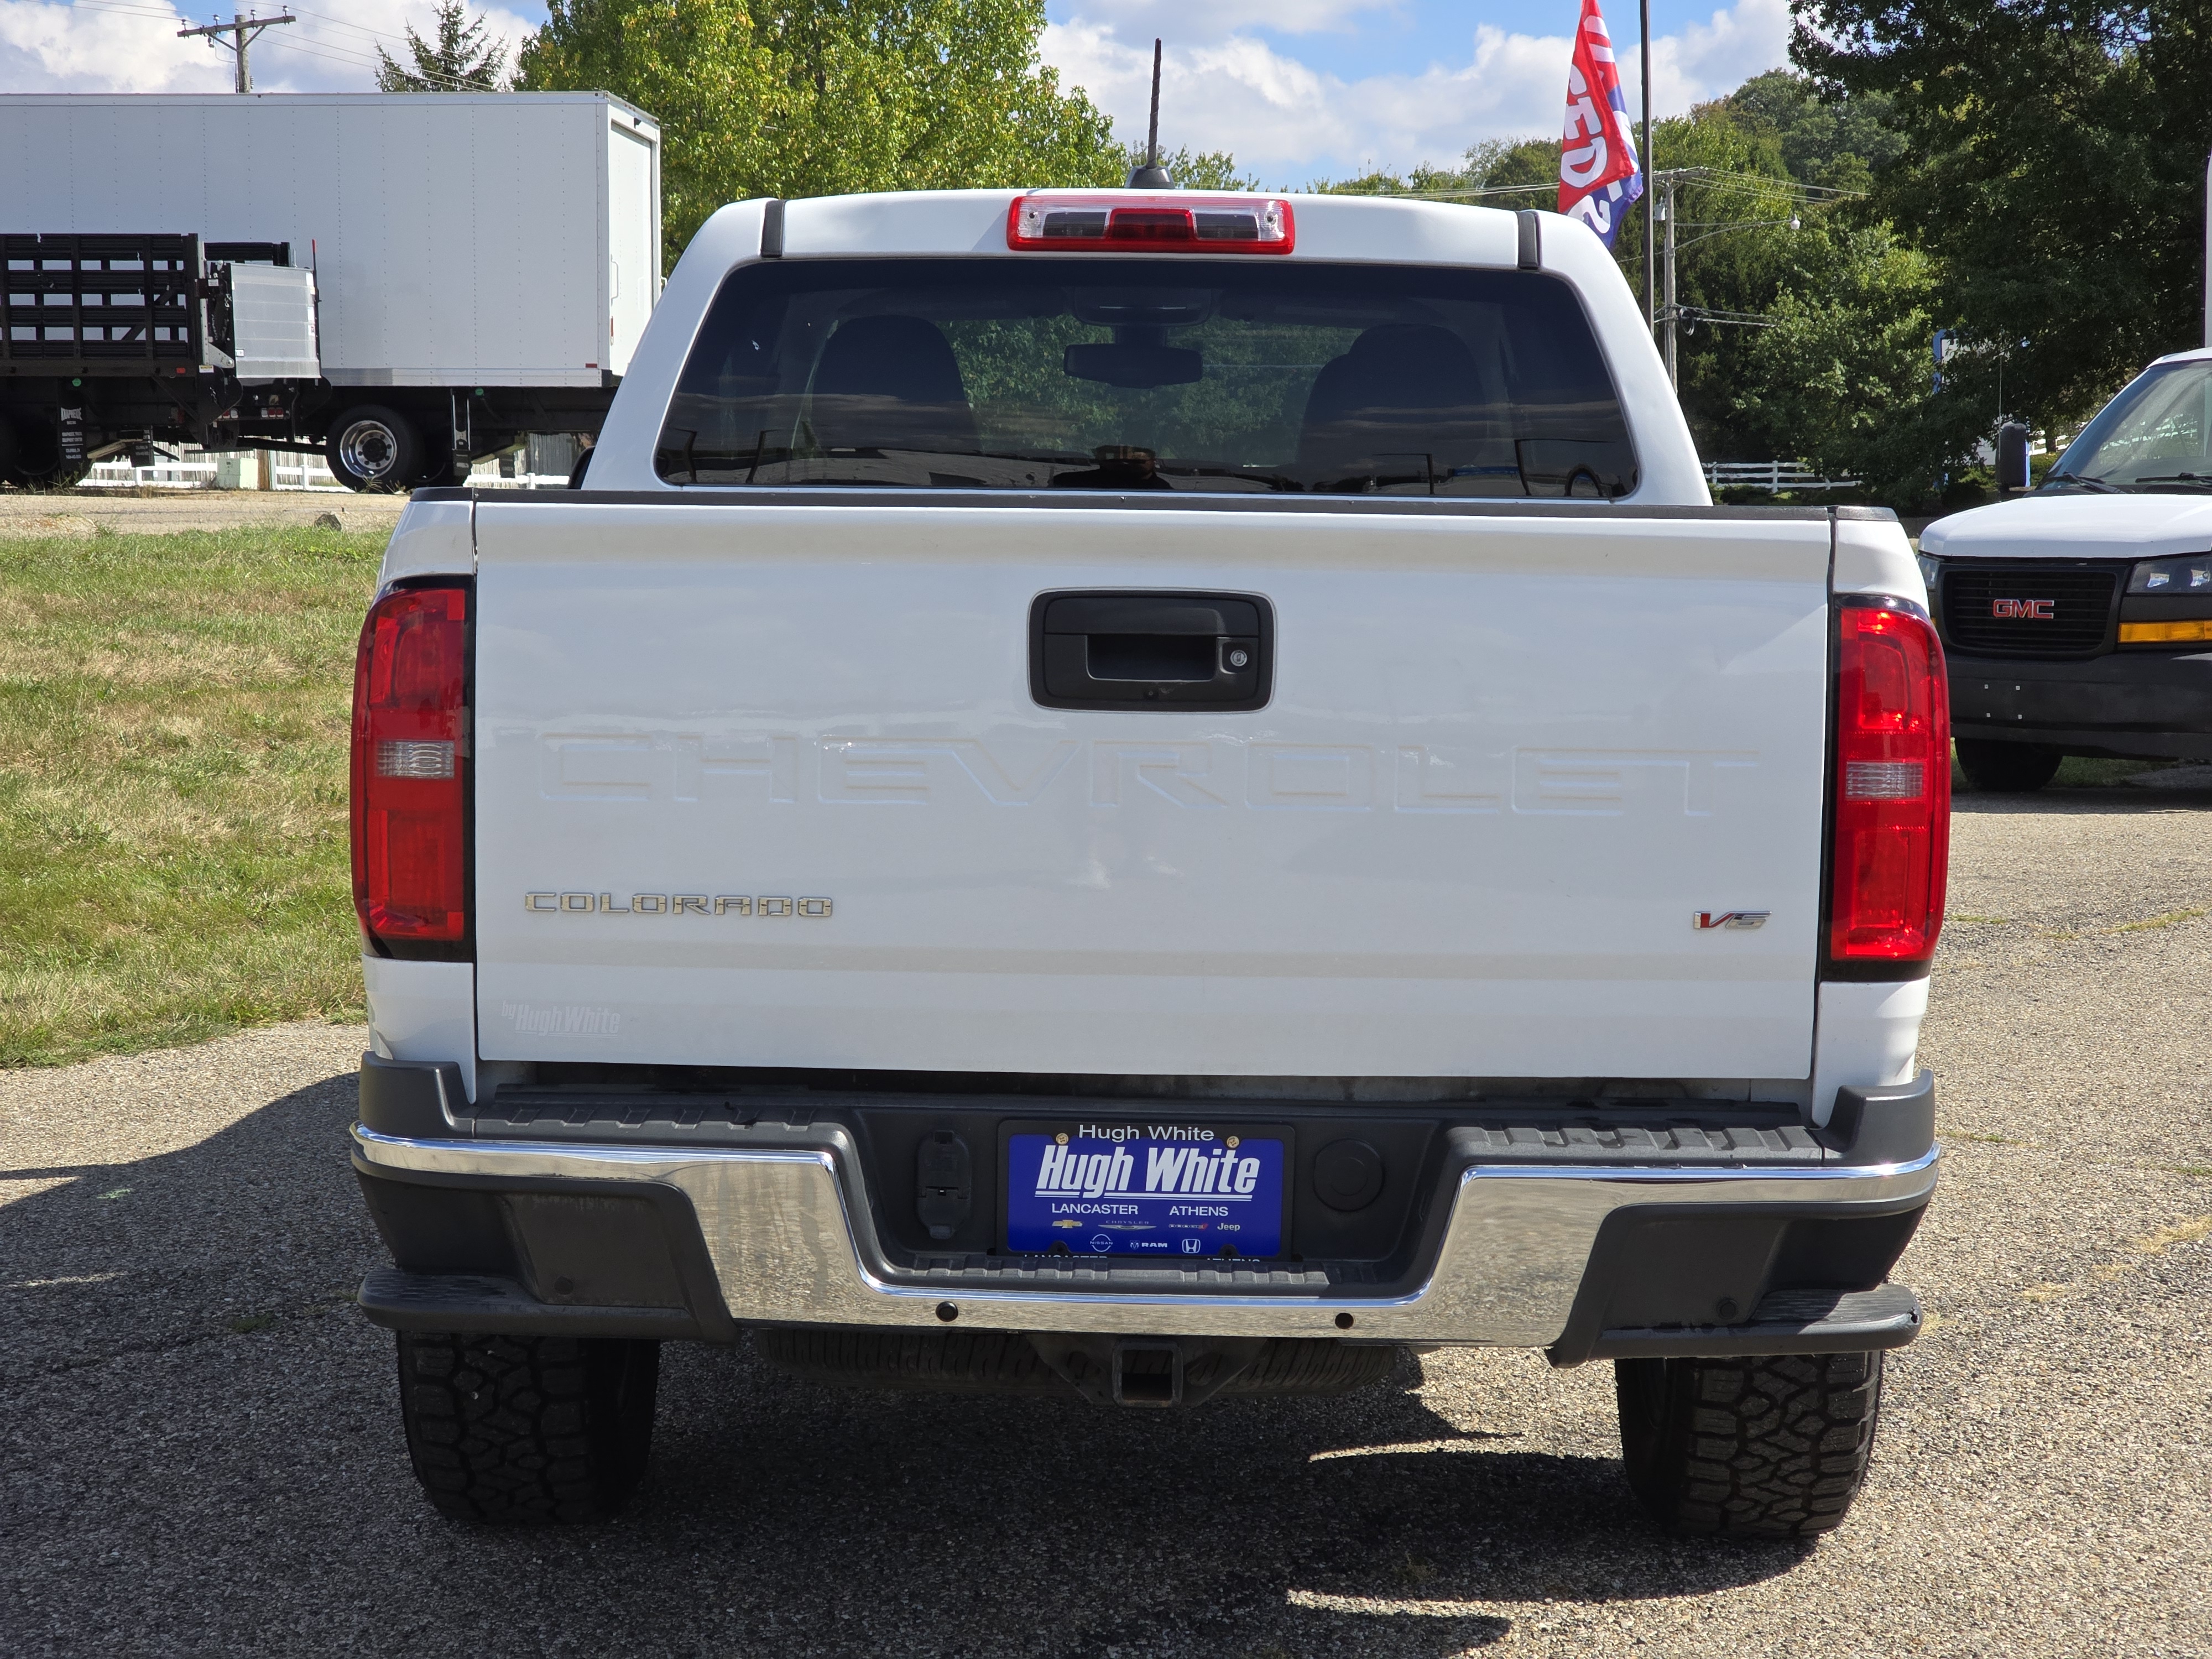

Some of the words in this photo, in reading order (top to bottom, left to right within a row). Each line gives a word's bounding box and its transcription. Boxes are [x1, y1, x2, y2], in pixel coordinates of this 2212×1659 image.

[1993, 599, 2054, 619] GMC
[540, 732, 1762, 816] CHEVROLET
[524, 891, 833, 917] COLORADO
[1693, 911, 1772, 930] V6
[1079, 1124, 1139, 1142] Hugh
[1147, 1125, 1214, 1141] White
[1036, 1145, 1134, 1198] Hugh
[1145, 1147, 1260, 1193] White
[1052, 1203, 1139, 1215] LANCASTER
[1168, 1206, 1229, 1217] ATHENS
[1217, 1223, 1240, 1232] Jeep
